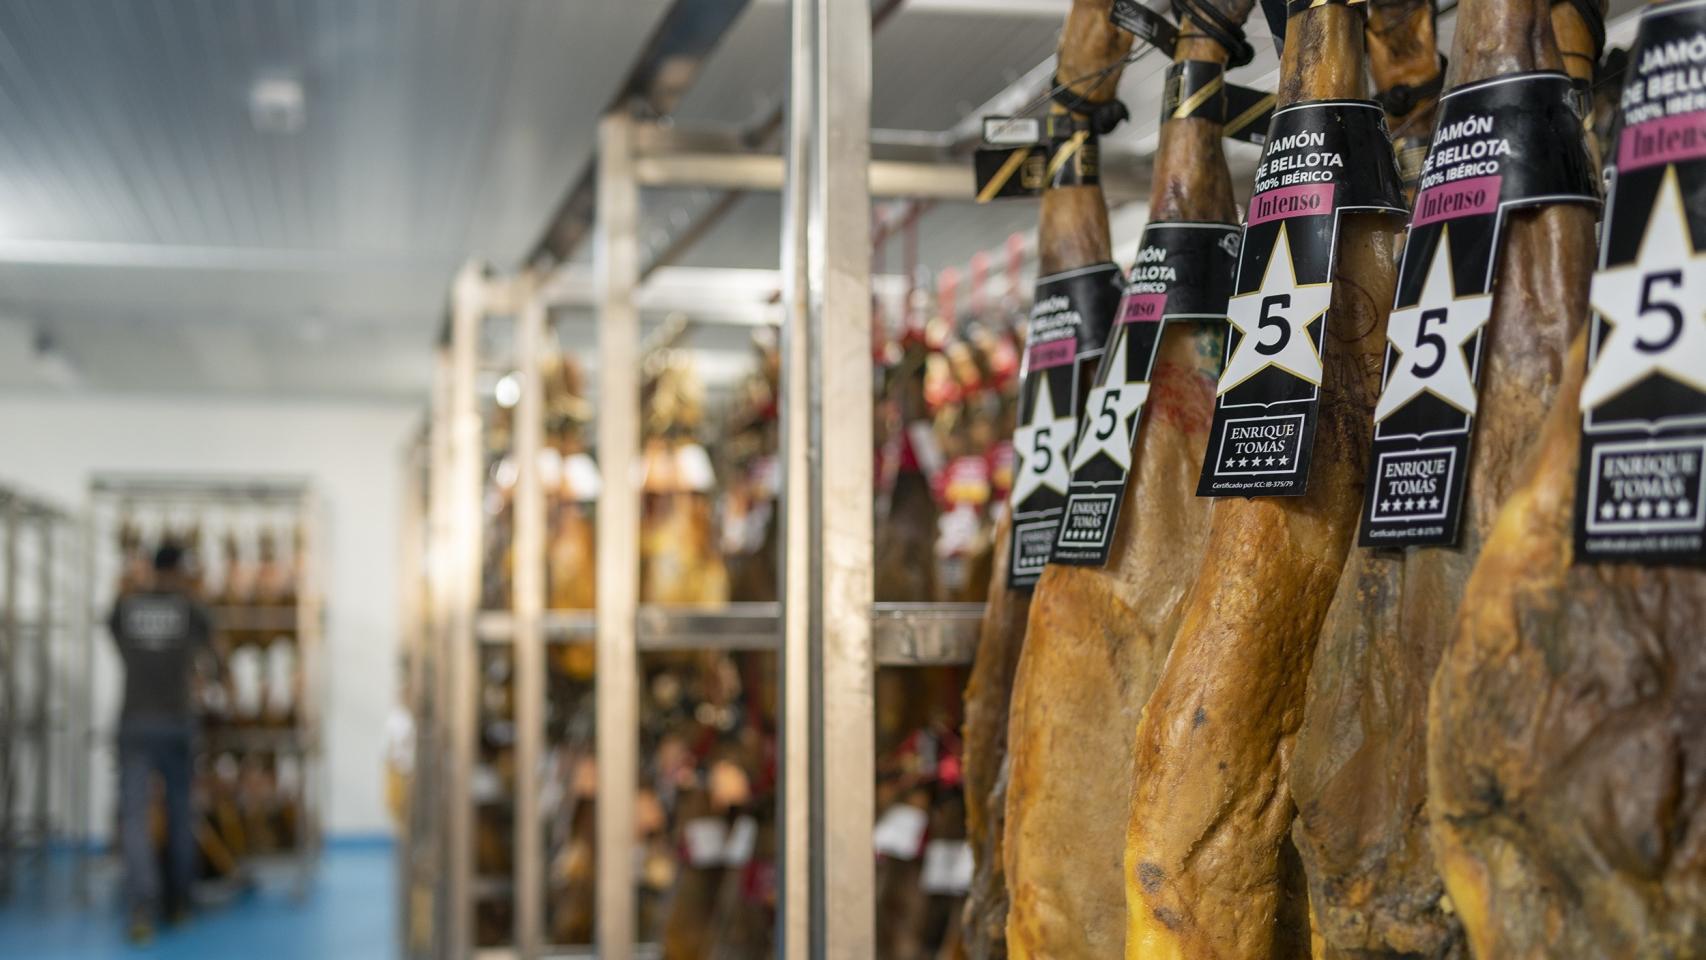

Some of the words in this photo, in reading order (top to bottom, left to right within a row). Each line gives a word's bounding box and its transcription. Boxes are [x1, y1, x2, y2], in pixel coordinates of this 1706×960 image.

[1648, 66, 1706, 99] BELL
[1266, 130, 1325, 156] JAMÓN
[1436, 139, 1511, 167] BELLOTA
[1270, 152, 1344, 174] BELLOTA
[1446, 160, 1499, 181] IBÉRICO
[1256, 177, 1279, 193] 100%
[1282, 170, 1333, 186] IBÉRICO
[1257, 193, 1321, 218] Intenso
[1422, 189, 1486, 219] Intenso
[1633, 268, 1685, 354] 5
[1254, 293, 1292, 356] 5
[1410, 307, 1449, 379] 5
[1095, 389, 1122, 441] 5
[1230, 424, 1295, 440] ENRIQUE
[1032, 427, 1053, 474] 5
[1235, 440, 1286, 454] TOMAS
[1384, 459, 1446, 478] ENRIQUE
[1389, 478, 1437, 495] TOMAS
